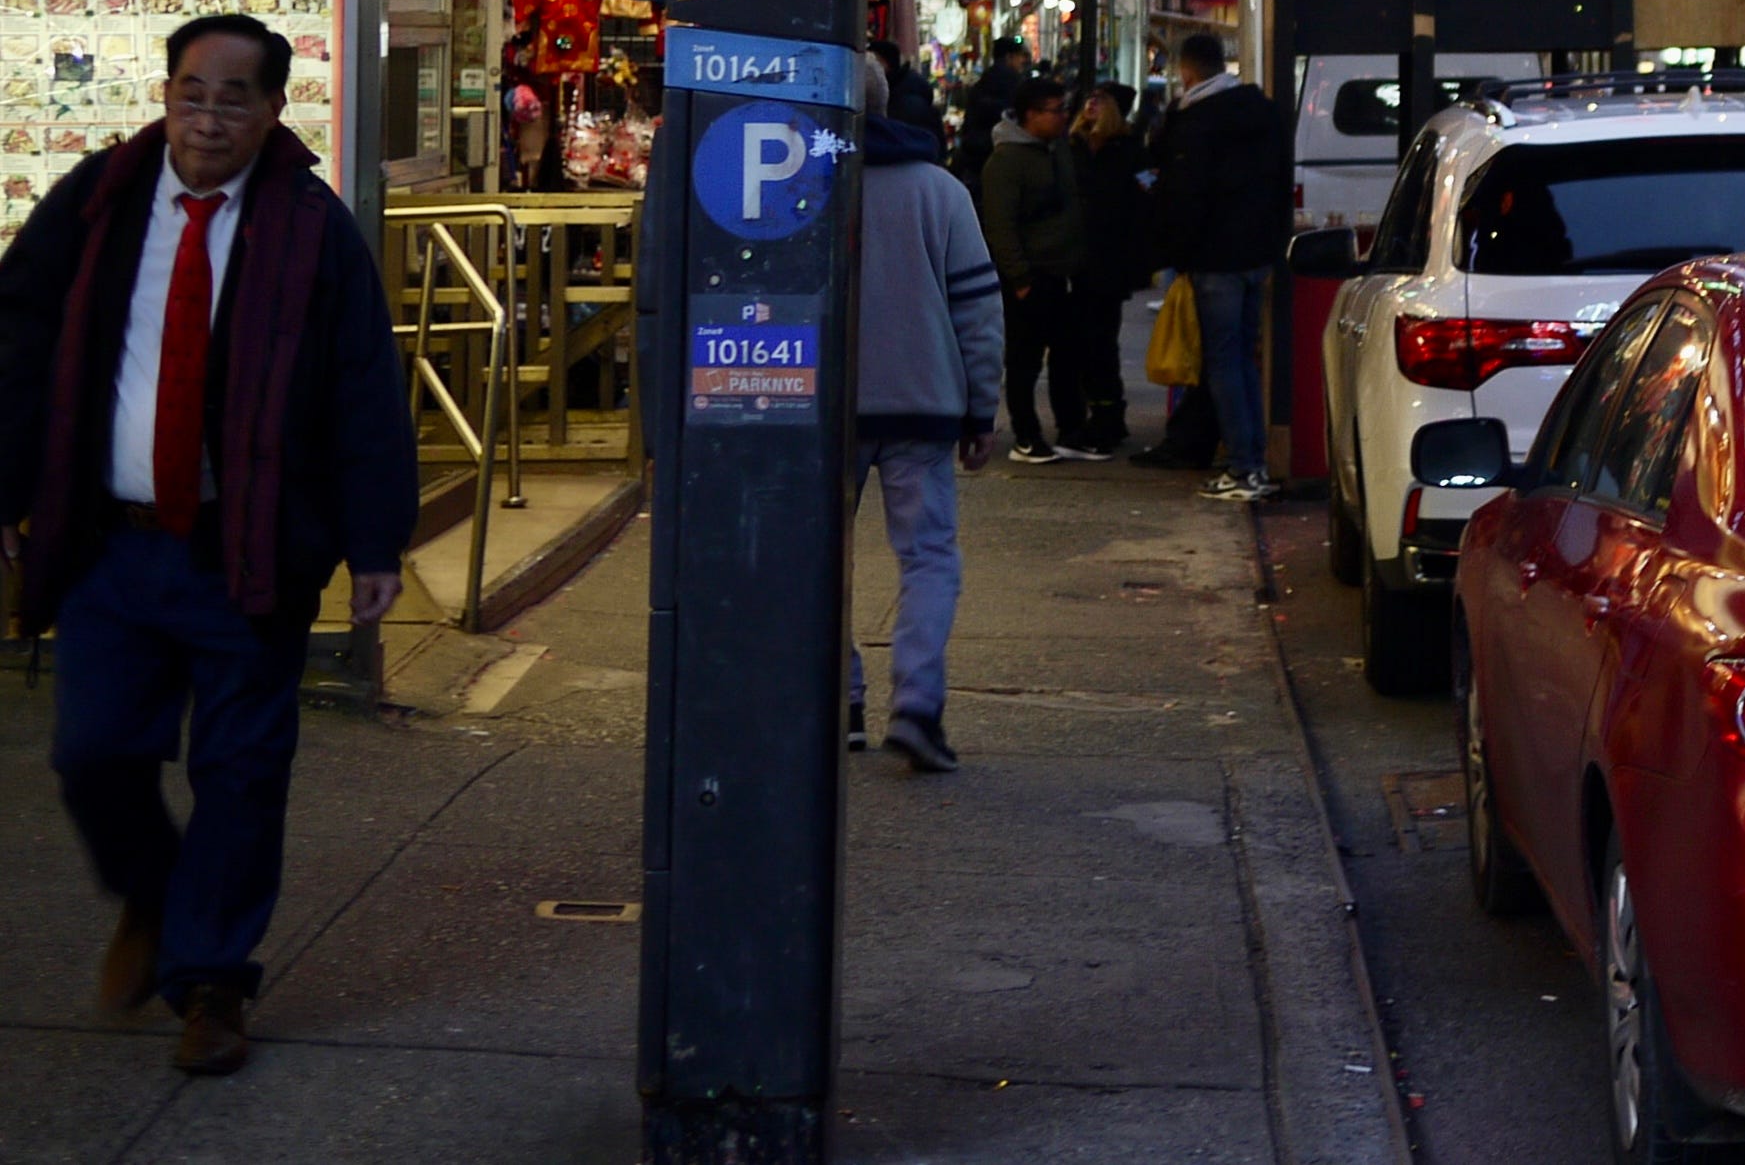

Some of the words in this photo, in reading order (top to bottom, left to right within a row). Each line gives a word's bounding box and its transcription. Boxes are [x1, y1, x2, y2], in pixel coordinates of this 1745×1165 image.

[694, 53, 797, 84] 101641
[742, 122, 807, 220] P
[706, 339, 804, 365] 101641
